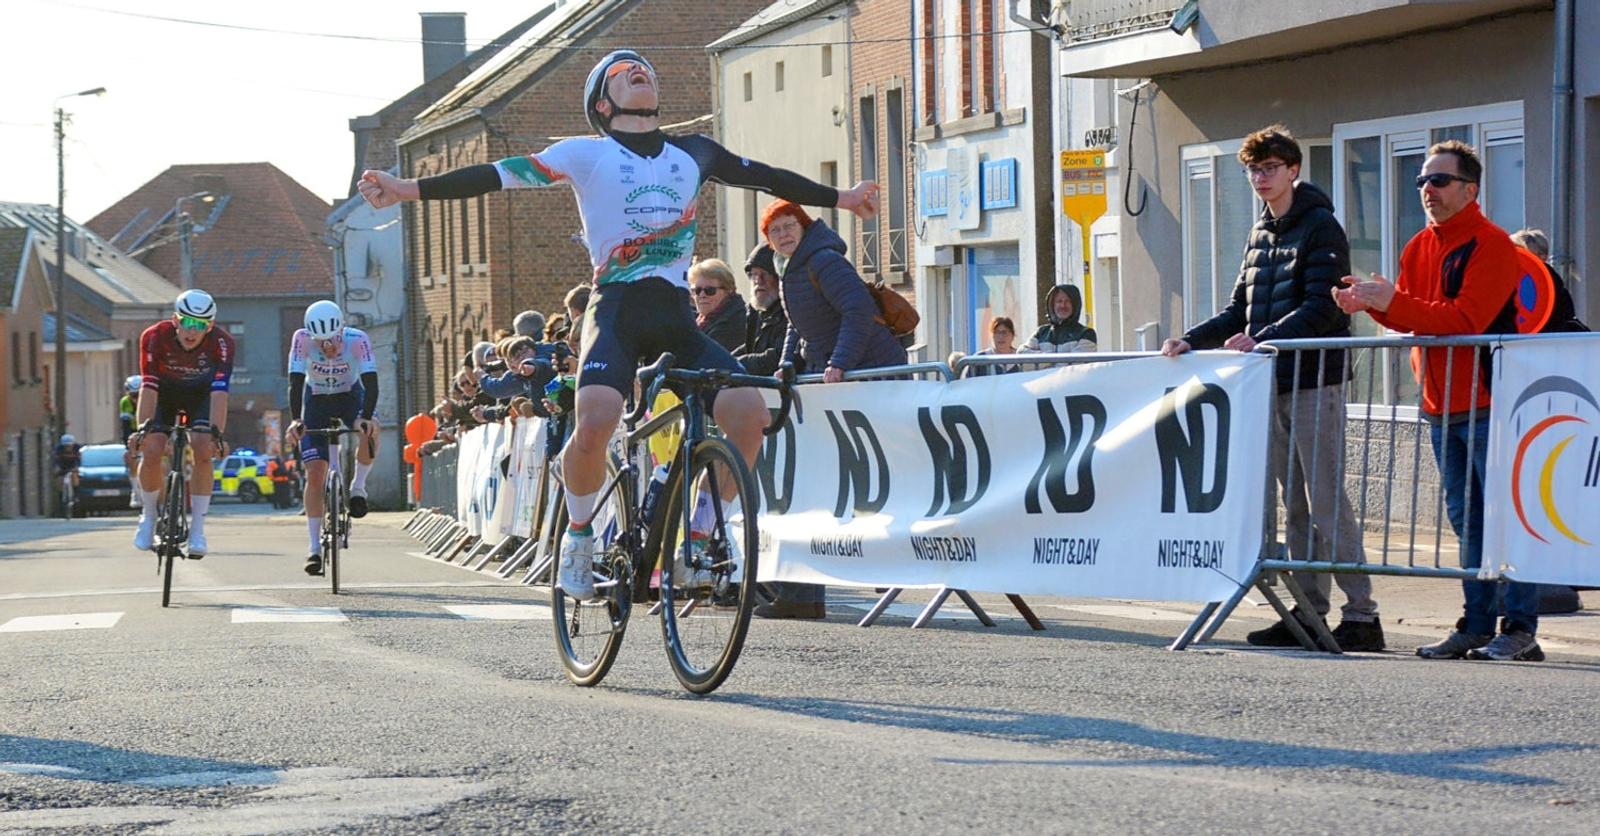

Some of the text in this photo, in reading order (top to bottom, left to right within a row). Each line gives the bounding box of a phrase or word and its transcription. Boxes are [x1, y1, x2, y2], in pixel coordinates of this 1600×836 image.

[1063, 157, 1088, 166] Zone
[624, 206, 683, 215] COPPI
[313, 365, 348, 374] Hubo
[810, 535, 864, 558] NIGHT&DAY
[911, 535, 977, 562] NIGHT&DAY
[1033, 537, 1100, 565] NIGHT&DAY
[1158, 539, 1224, 569] NIGHT&DAY
